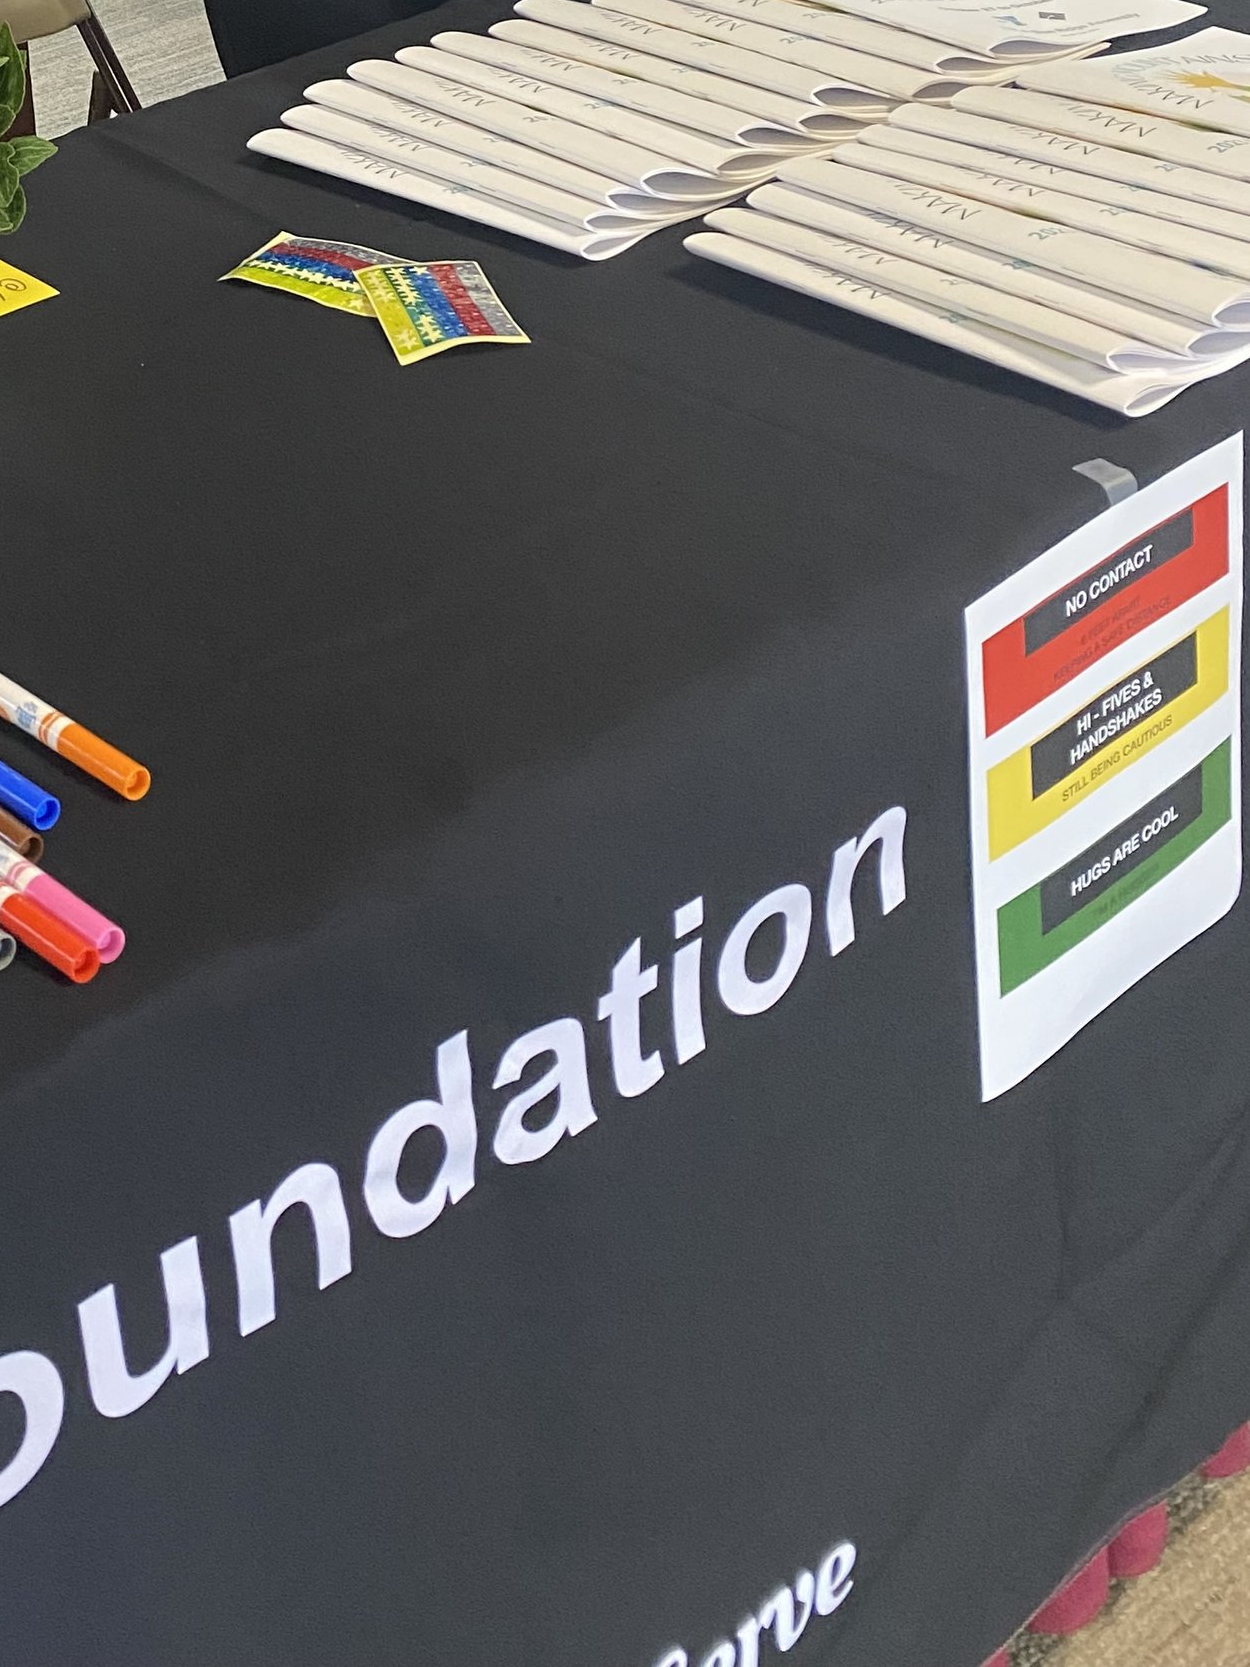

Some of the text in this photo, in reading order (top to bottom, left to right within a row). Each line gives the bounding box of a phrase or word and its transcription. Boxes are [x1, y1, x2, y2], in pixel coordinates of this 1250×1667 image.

[1066, 544, 1153, 617] NO CONTACT
[1070, 688, 1162, 765] HANDSHAKES
[1077, 717, 1091, 736] HI
[1102, 679, 1141, 717] FIVES
[1143, 671, 1154, 687] &
[1062, 714, 1173, 802] STILL BEING CAUTIOUS
[1071, 856, 1111, 897] HUGS
[1113, 833, 1140, 866] ARE
[1142, 806, 1179, 842] COOL
